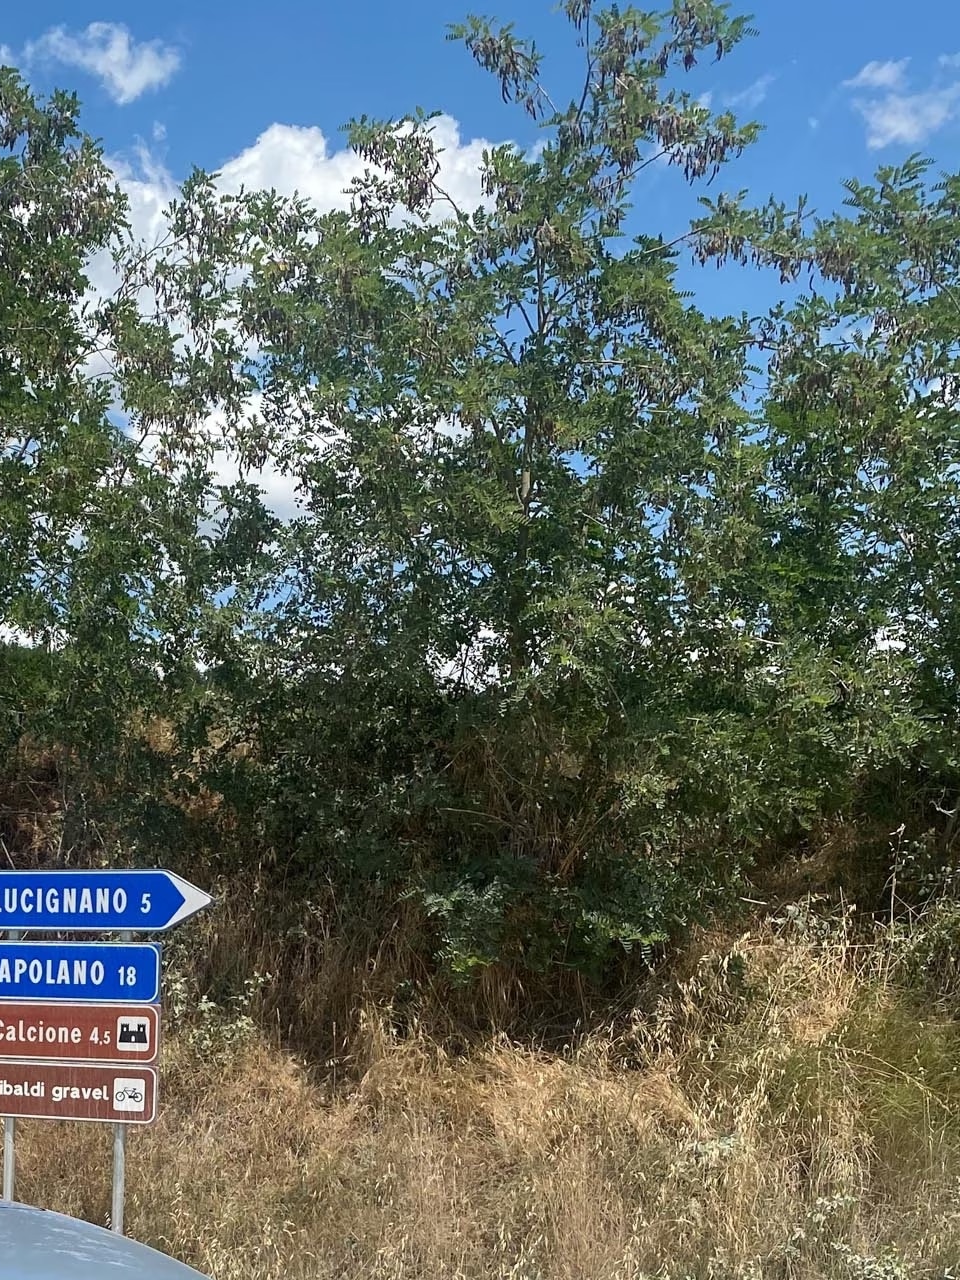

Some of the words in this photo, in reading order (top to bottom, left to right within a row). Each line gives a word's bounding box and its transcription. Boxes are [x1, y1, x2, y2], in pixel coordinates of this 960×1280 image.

[140, 892, 152, 914] 5
[117, 966, 137, 986] 18
[52, 1083, 109, 1101] gravel
